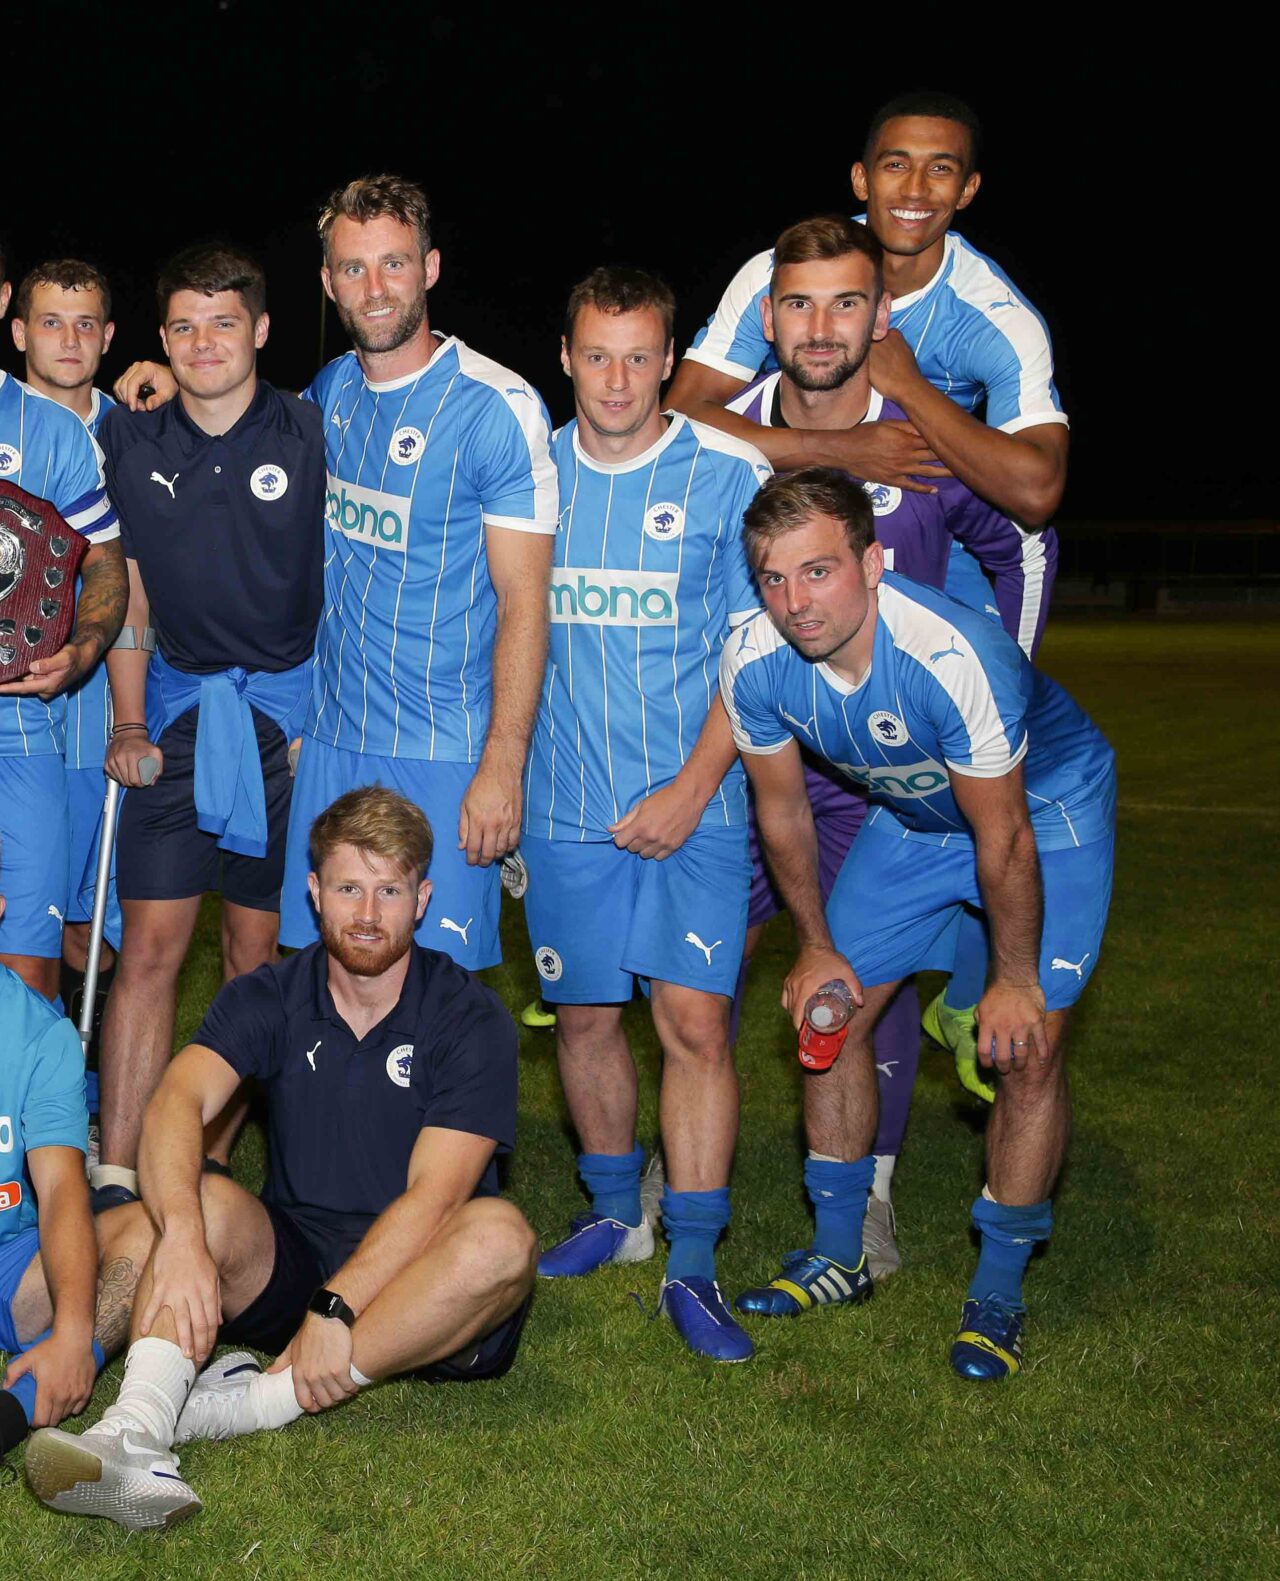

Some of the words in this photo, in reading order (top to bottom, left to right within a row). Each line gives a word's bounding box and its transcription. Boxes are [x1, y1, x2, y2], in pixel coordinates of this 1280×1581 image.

[399, 429, 421, 439] CHESTER
[257, 465, 281, 475] CHESTER
[653, 504, 679, 513] CHESTER
[549, 575, 672, 619] mbna
[873, 712, 897, 722] CHESTER
